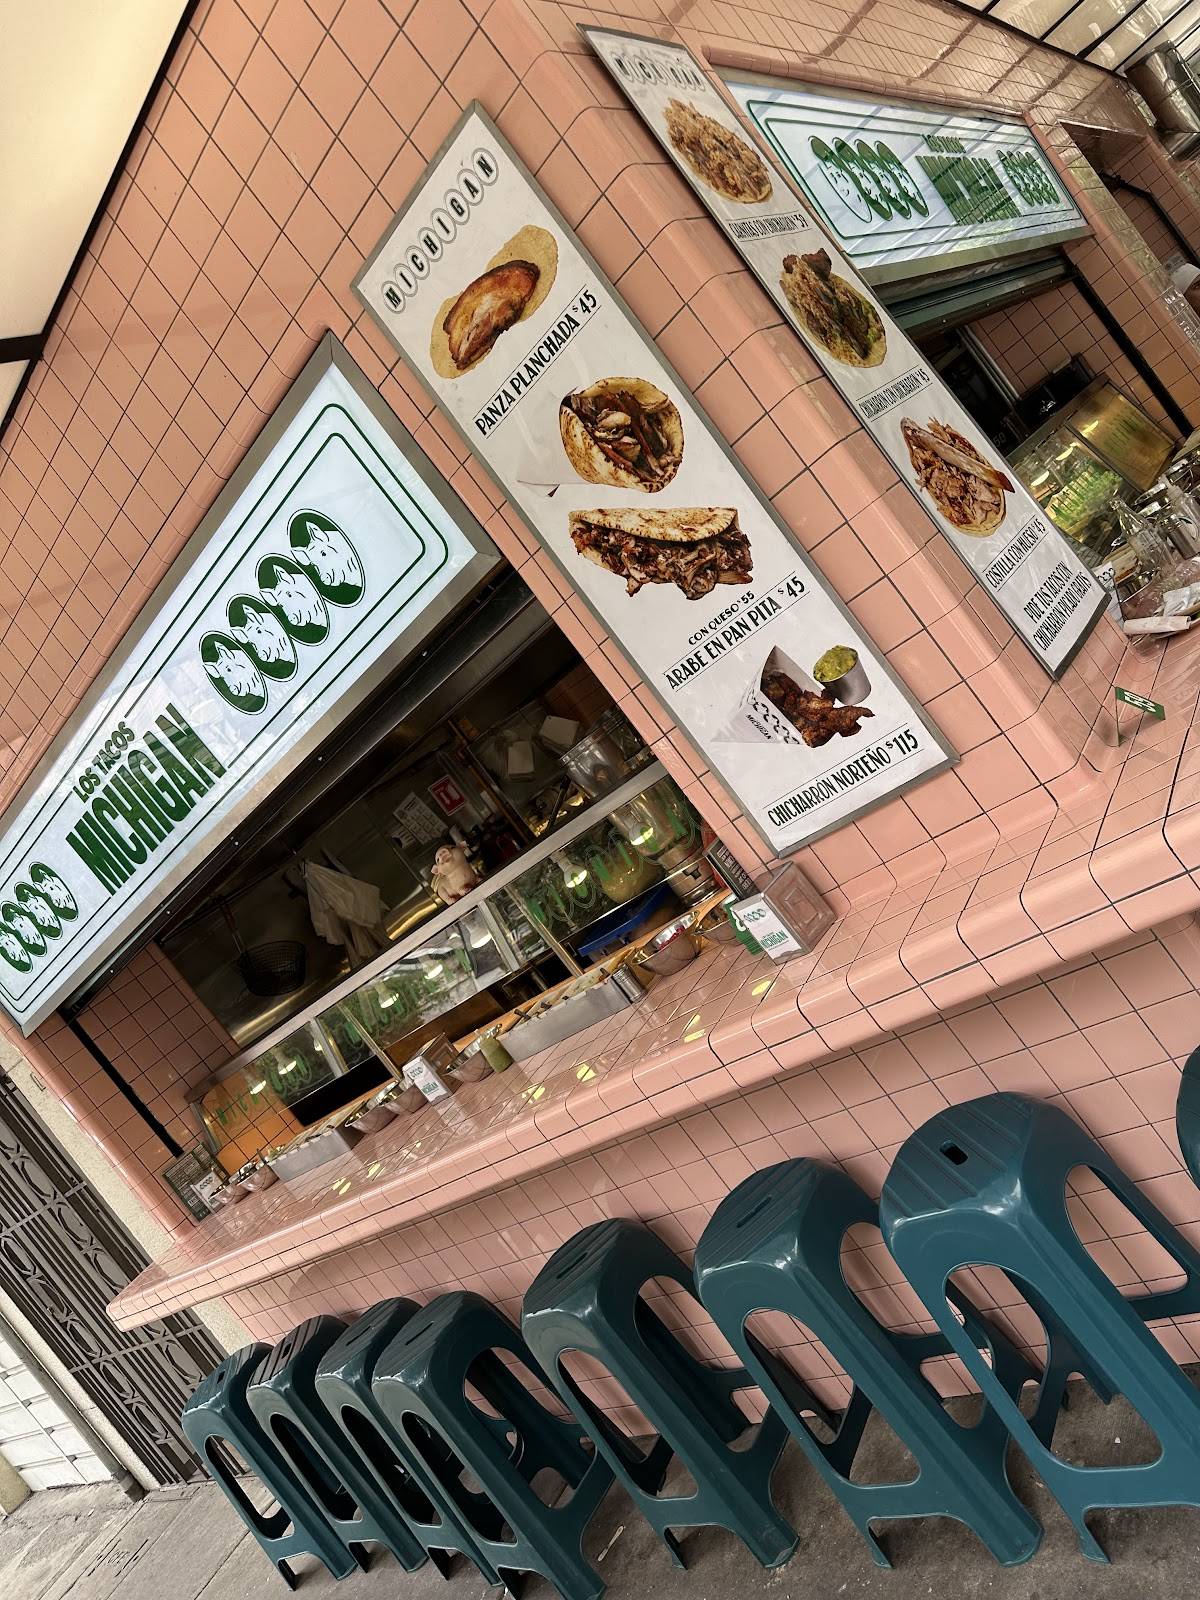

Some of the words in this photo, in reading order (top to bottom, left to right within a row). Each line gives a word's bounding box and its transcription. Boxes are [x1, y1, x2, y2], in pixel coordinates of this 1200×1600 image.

[475, 389, 516, 436] PANZA
[510, 314, 580, 395] PLANCHADA
[571, 289, 598, 314] $45
[985, 553, 1016, 589] COSTILLA
[1007, 542, 1025, 563] CON
[1016, 526, 1039, 553] HUESO
[1023, 597, 1045, 624] PIDE
[1034, 586, 1053, 610] TUS
[1044, 571, 1065, 599] TACOS
[1055, 560, 1073, 583] CON
[1057, 587, 1081, 618] PICADO
[1070, 571, 1092, 599] GRATIS
[688, 626, 710, 645] CON
[708, 603, 740, 631] QUESO
[703, 637, 727, 660] EN
[721, 618, 752, 647] PAN
[747, 597, 782, 627] PITA
[778, 576, 805, 598] $45
[65, 703, 227, 896] MICHIGAN
[73, 768, 102, 803] LOS
[94, 721, 135, 775] TACOS
[767, 778, 838, 827] CHICHARRÓN
[831, 746, 892, 791] NORTEÑO
[885, 728, 919, 755] $115
